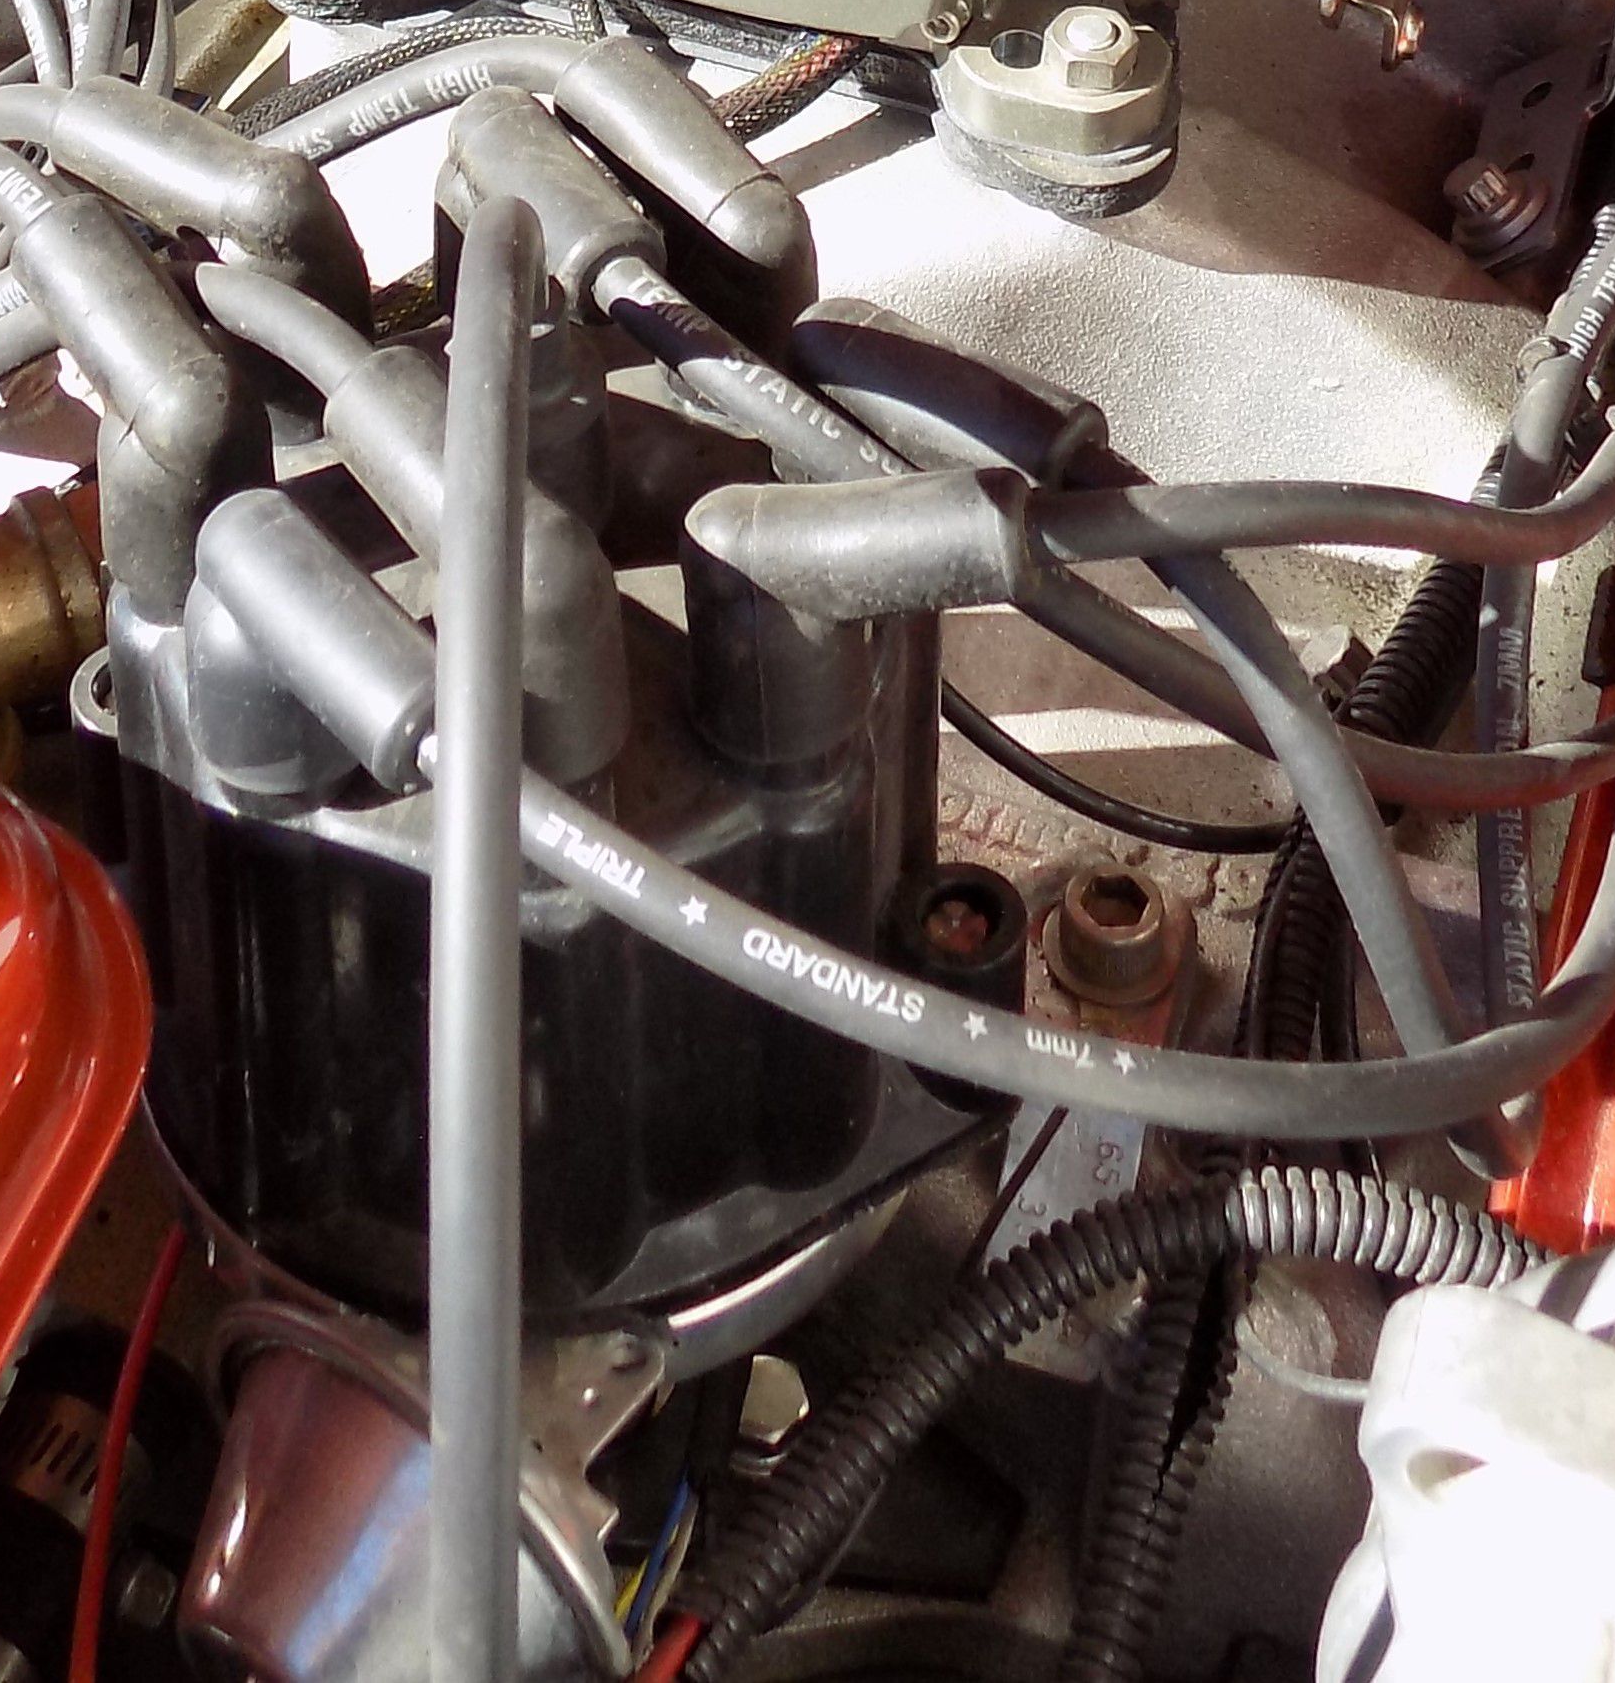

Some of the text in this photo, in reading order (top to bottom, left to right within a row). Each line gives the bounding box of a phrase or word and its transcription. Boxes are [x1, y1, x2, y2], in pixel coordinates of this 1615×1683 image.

[347, 86, 420, 137] TEMP
[424, 61, 493, 103] HIGH
[1566, 305, 1606, 361] HIGH
[723, 354, 842, 441] STATIC
[1496, 626, 1525, 691] 7MM
[538, 811, 1095, 1070] 7mm STANDARD TRIPLE
[1500, 919, 1535, 1012] STATIC
